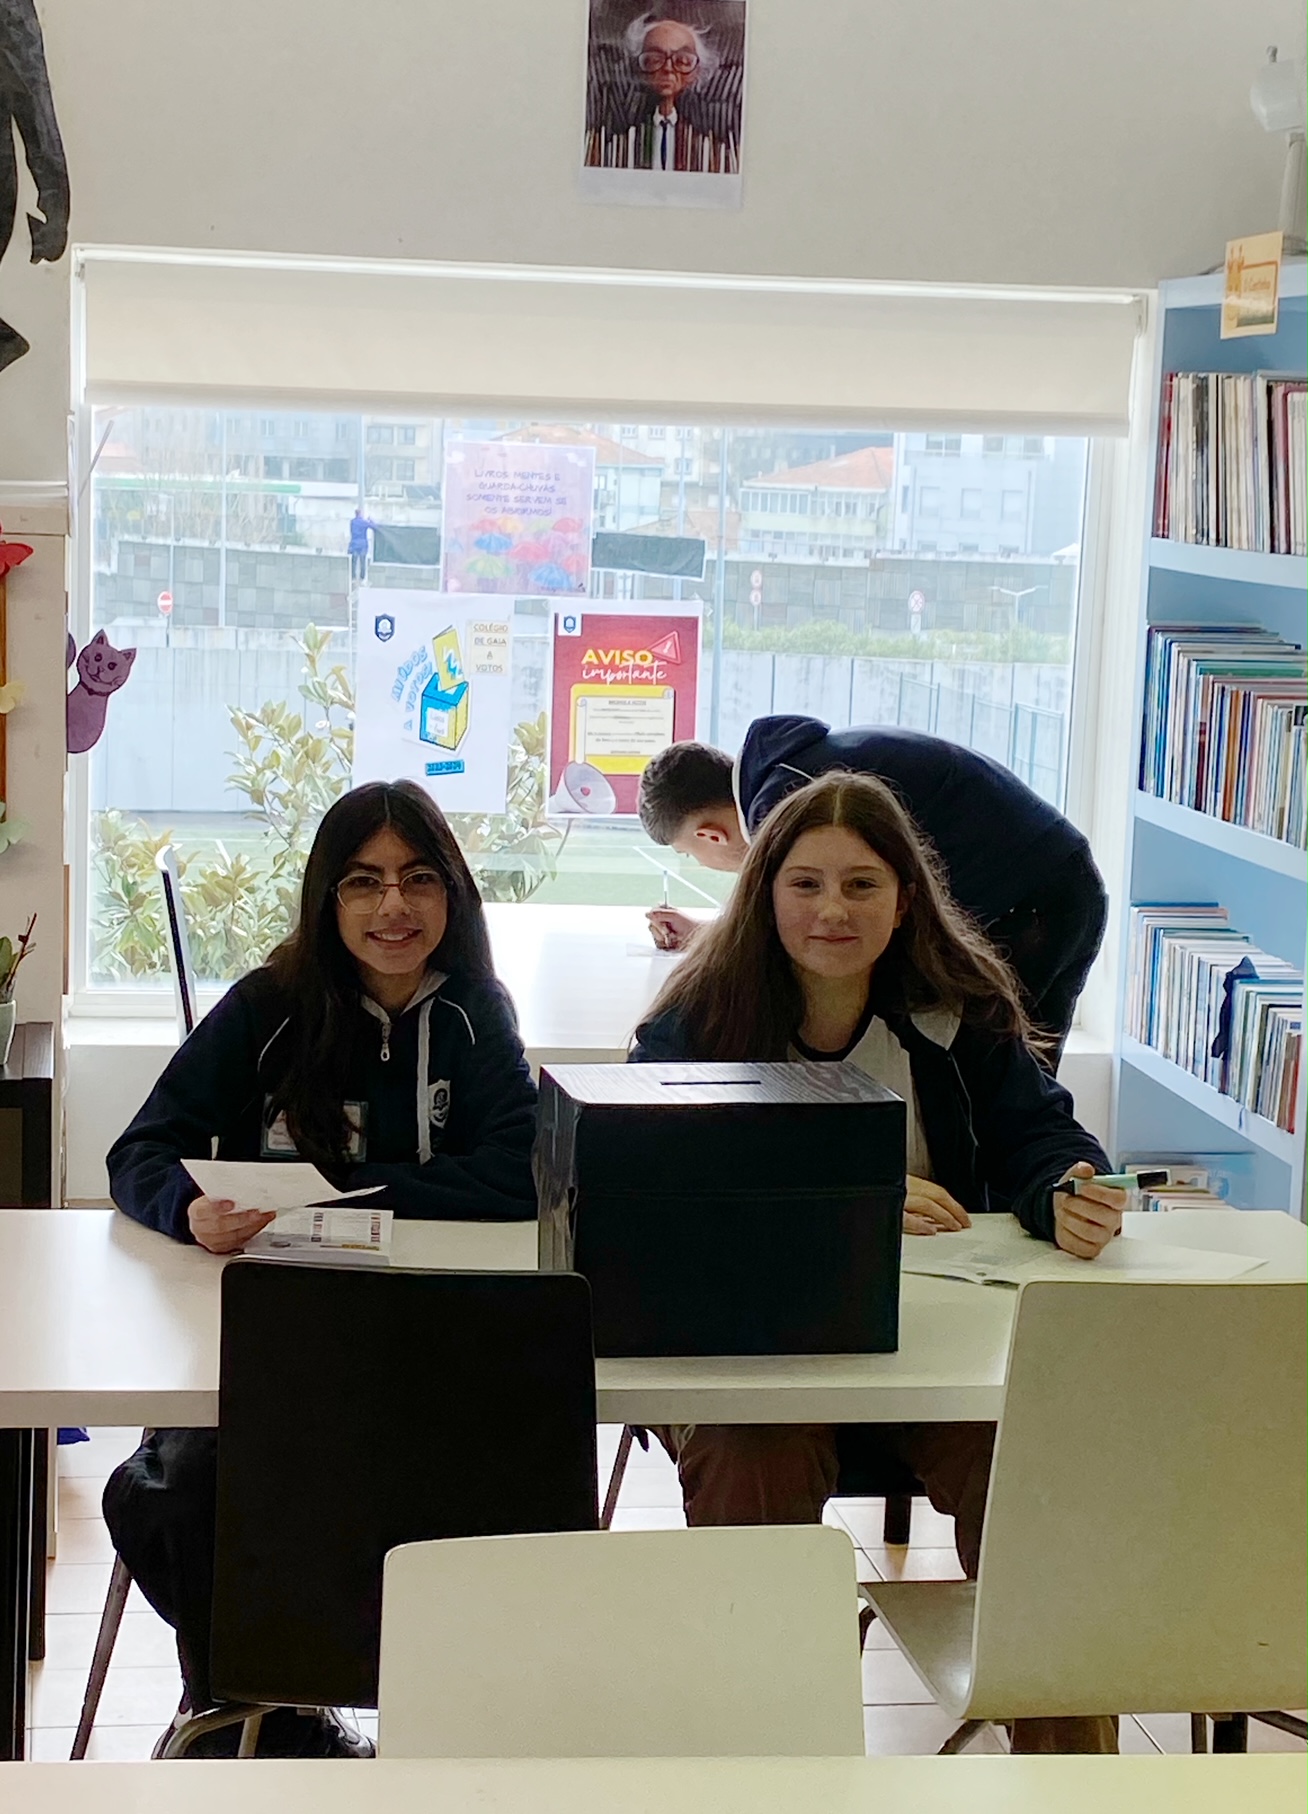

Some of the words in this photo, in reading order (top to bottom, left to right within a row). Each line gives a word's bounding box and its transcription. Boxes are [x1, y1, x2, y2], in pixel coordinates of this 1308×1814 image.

[474, 470, 509, 479] LIVROS
[514, 472, 551, 481] MENTES
[555, 473, 561, 482] E
[513, 495, 552, 504] SERVEM
[485, 506, 498, 514] OS
[473, 622, 508, 633] COLÉGIO
[475, 637, 485, 645] DE
[487, 637, 507, 646] GAIA
[582, 649, 653, 666] AVISO
[475, 663, 503, 673] VOTOS
[582, 661, 667, 685] importante
